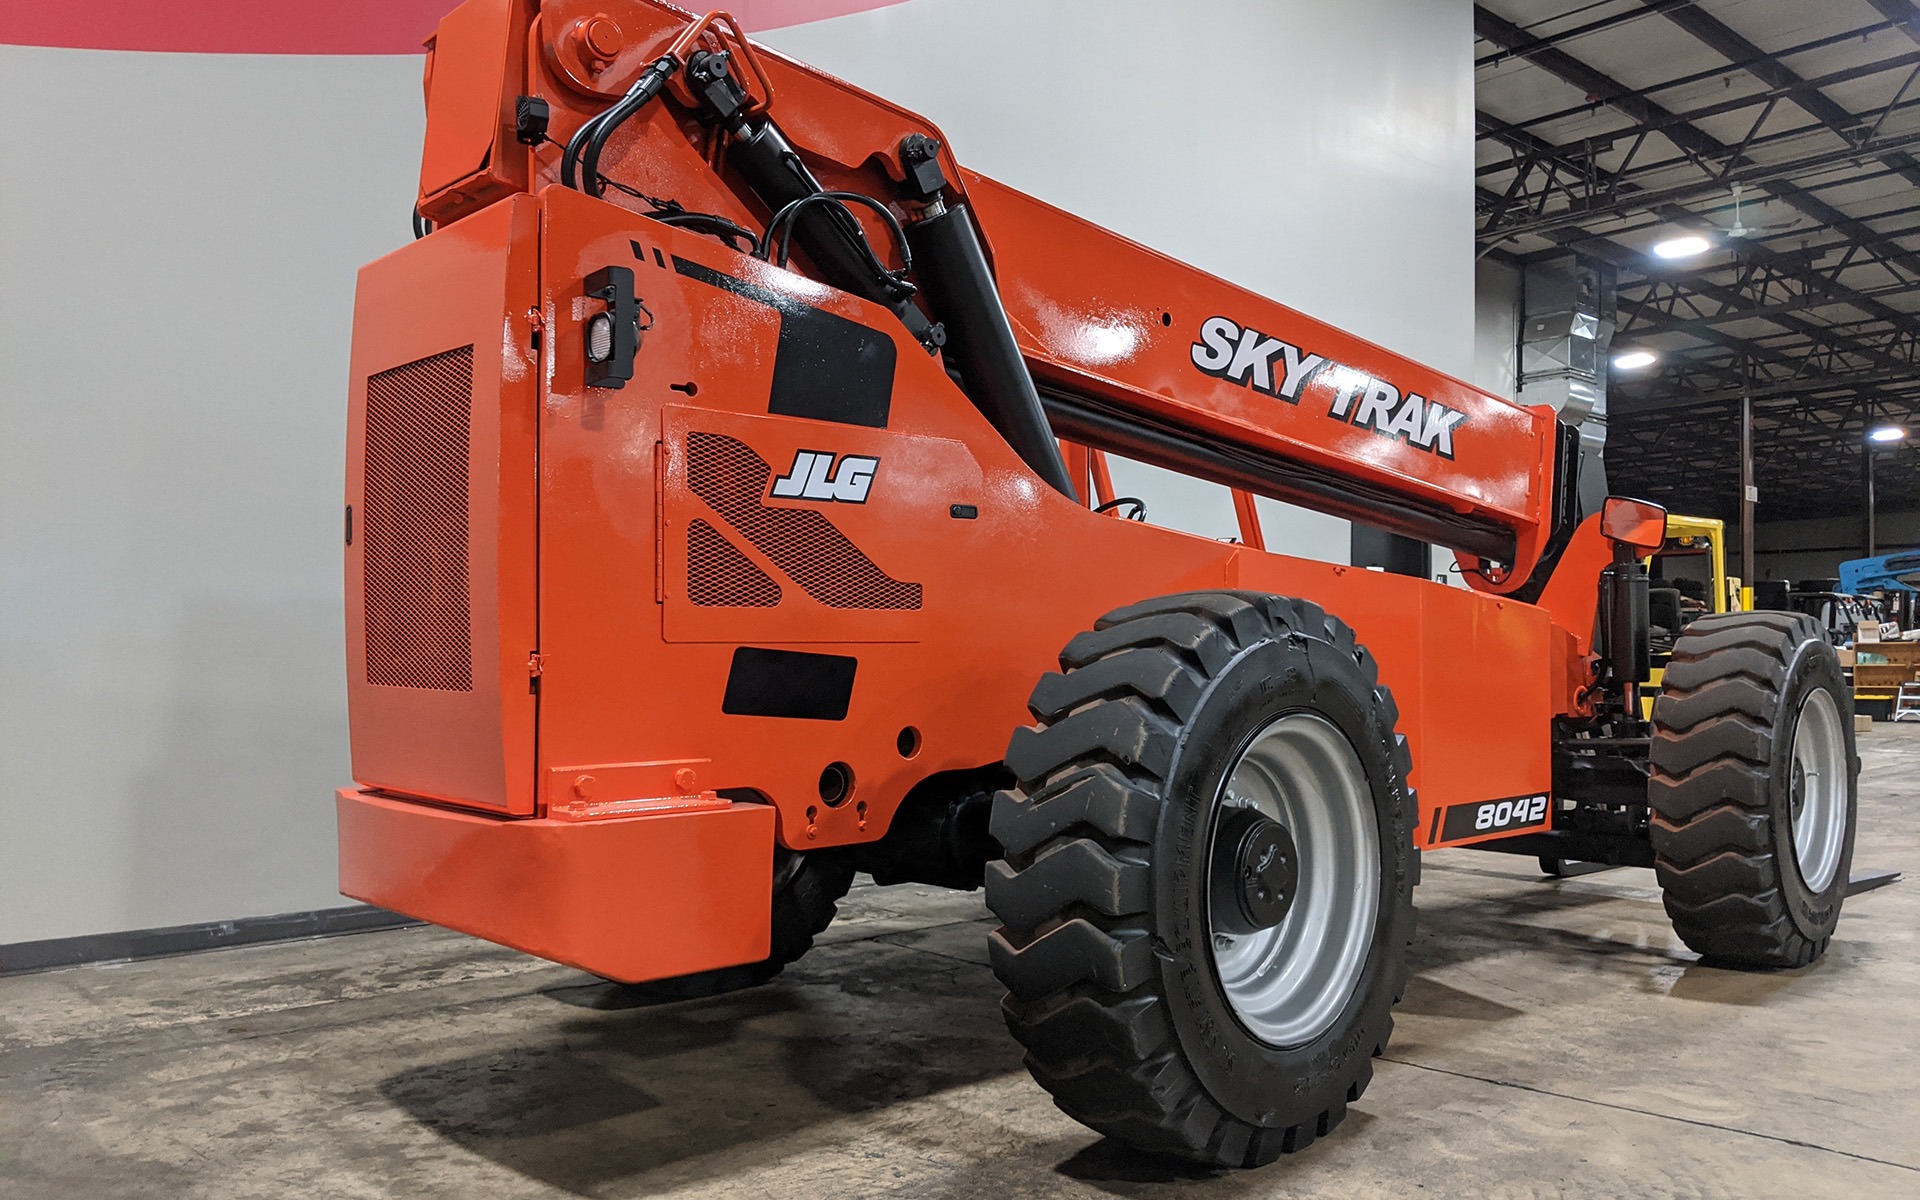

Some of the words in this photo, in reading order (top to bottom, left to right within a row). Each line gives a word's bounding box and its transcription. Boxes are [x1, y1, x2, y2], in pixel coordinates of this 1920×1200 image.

[1190, 315, 1328, 404] SKY
[1326, 362, 1469, 460] TRAK
[770, 450, 880, 504] JLG
[1475, 796, 1547, 831] 8042
